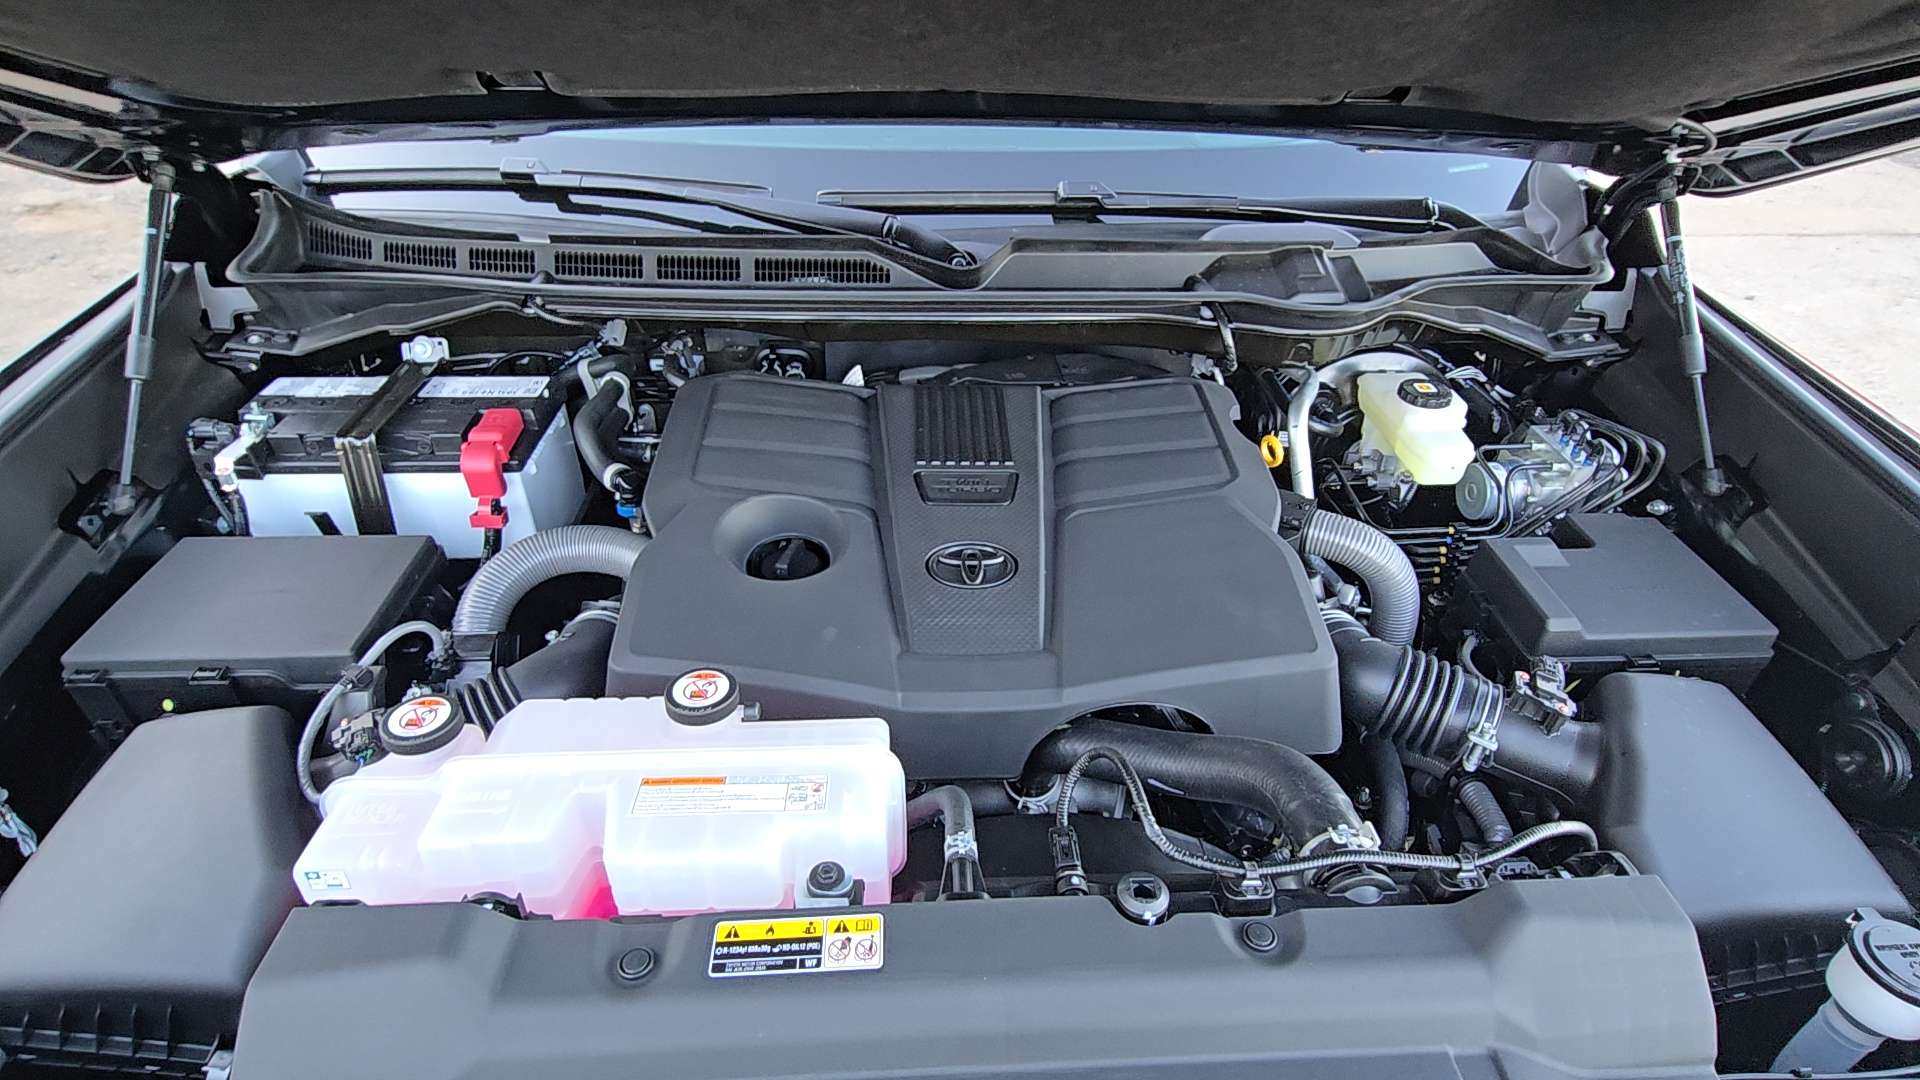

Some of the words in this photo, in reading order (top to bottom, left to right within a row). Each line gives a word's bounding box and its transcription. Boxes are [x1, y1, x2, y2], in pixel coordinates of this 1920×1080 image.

[939, 477, 990, 485] TWIN
[931, 485, 1003, 494] TURBO
[804, 958, 818, 968] WF
